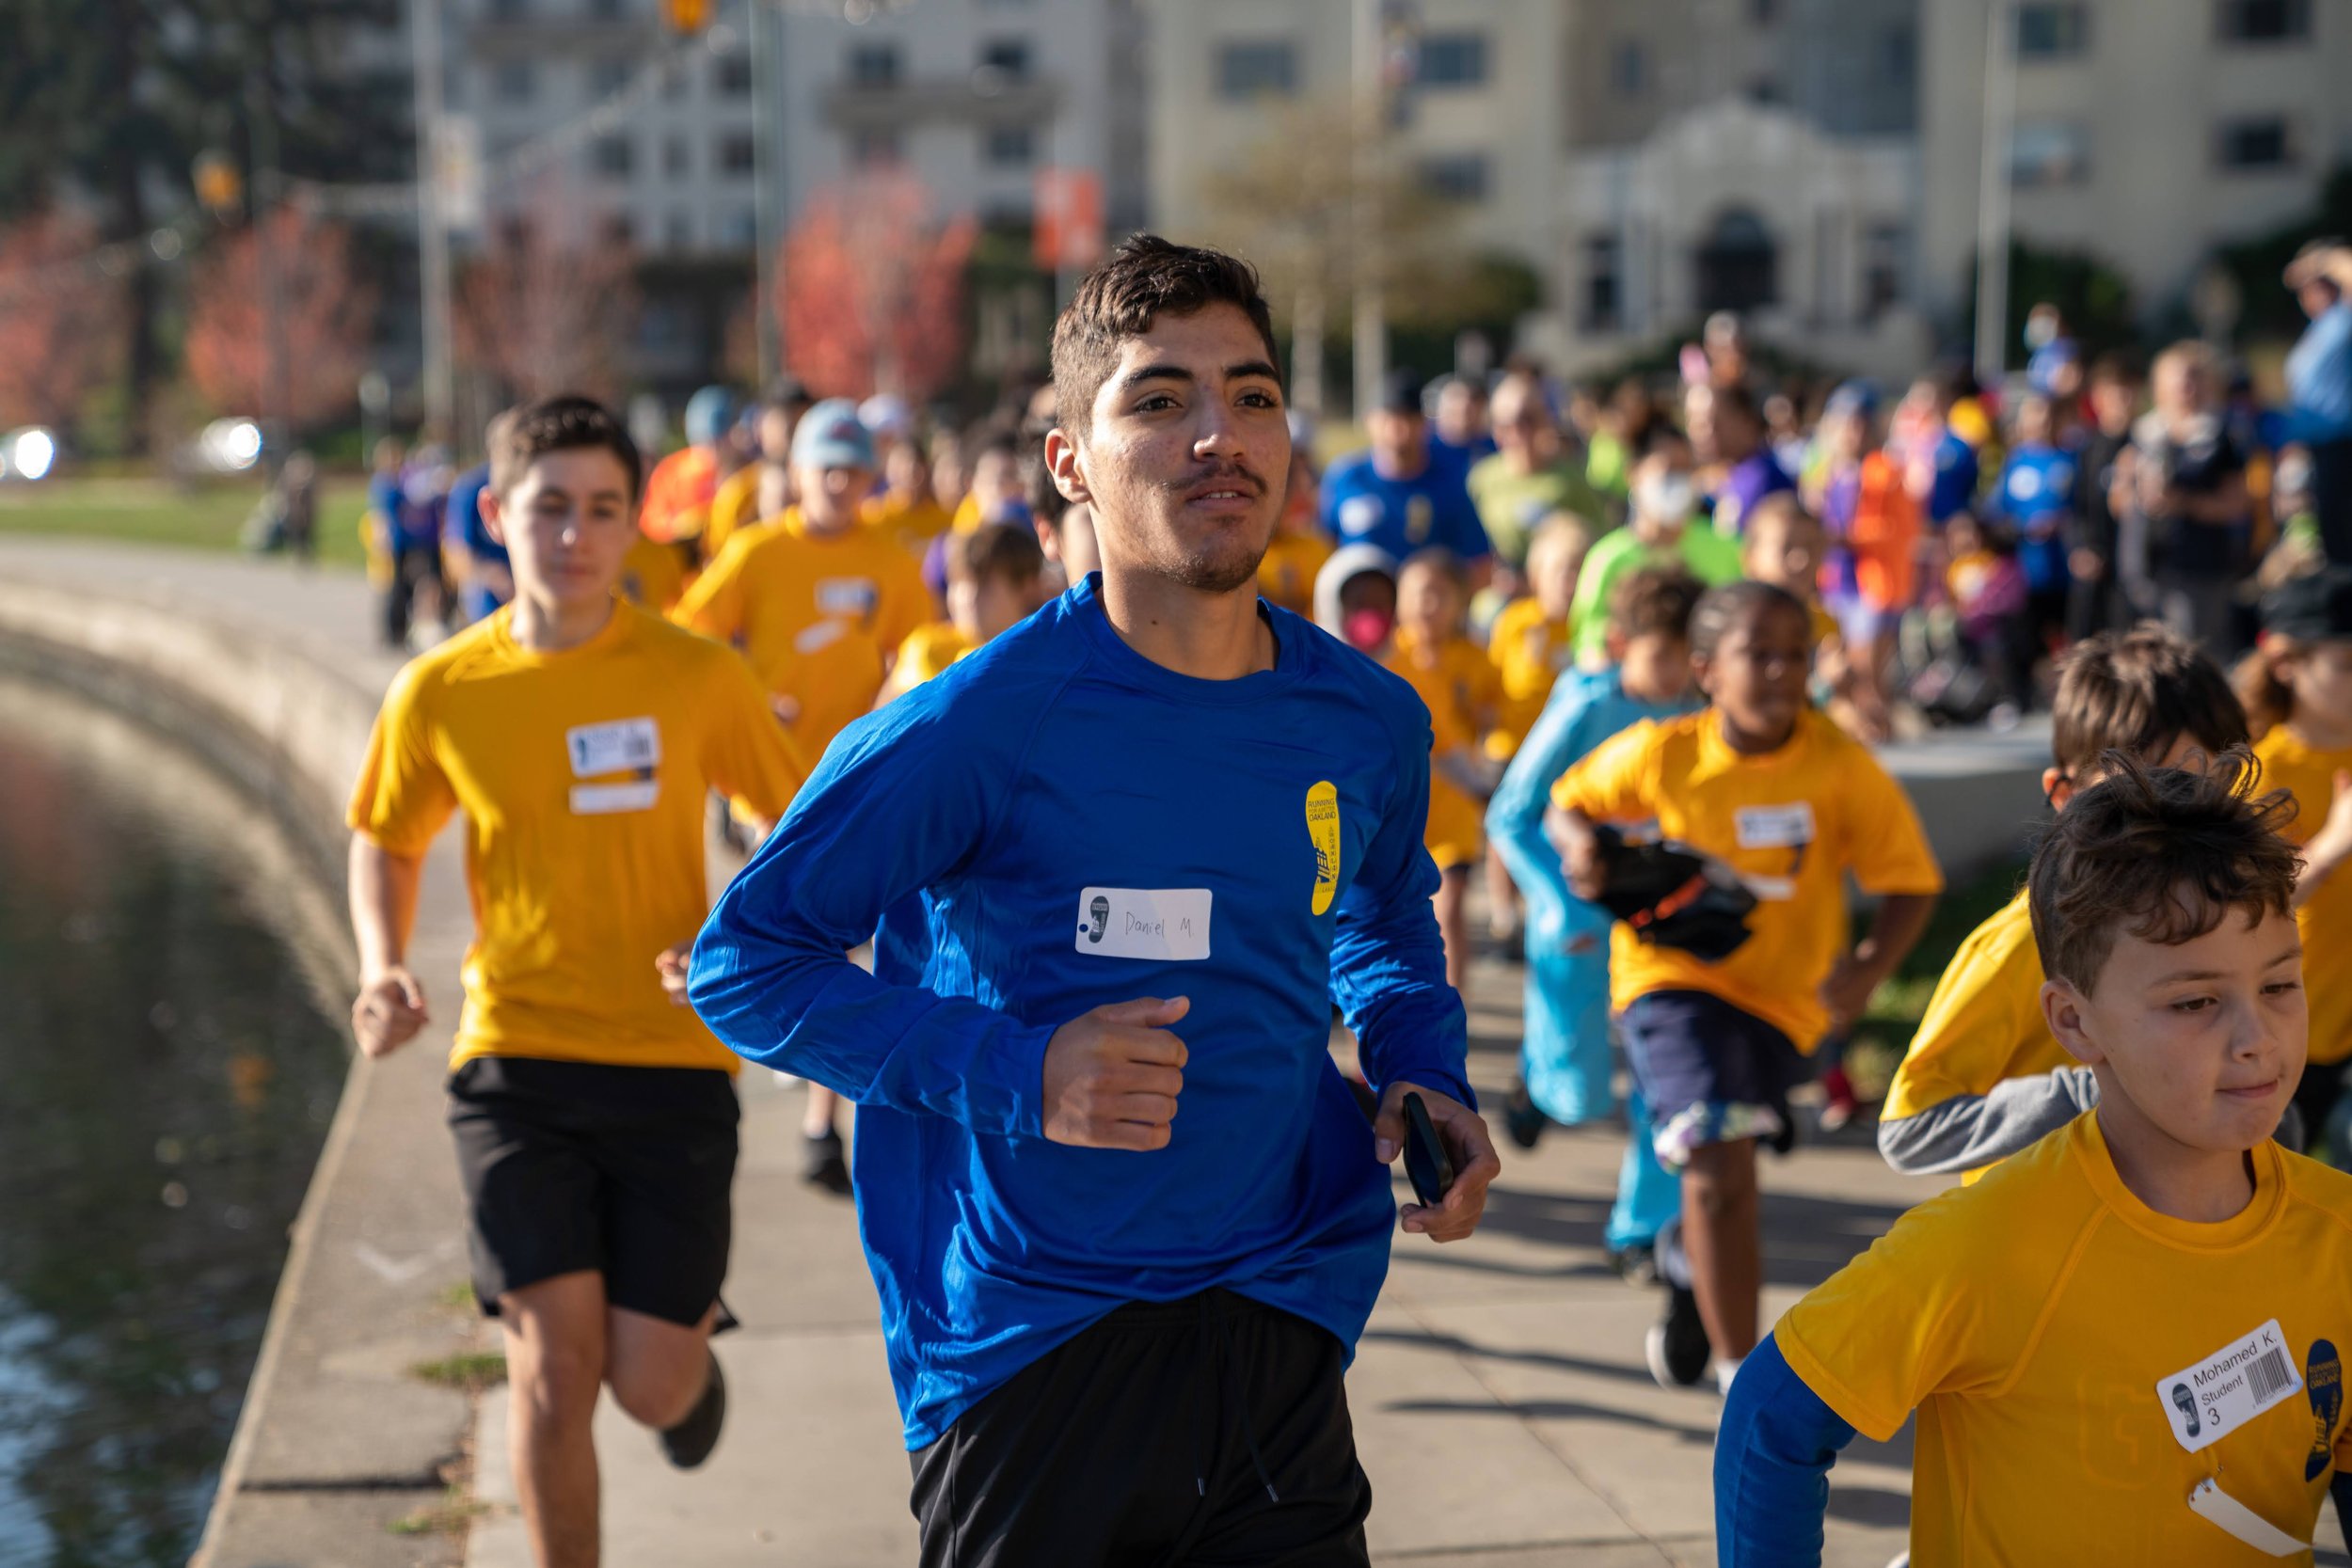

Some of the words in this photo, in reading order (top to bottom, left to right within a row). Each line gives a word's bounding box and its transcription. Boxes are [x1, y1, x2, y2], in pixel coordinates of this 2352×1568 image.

[1310, 812, 1336, 821] OAKLAND
[1125, 911, 1165, 938] Daniel
[2193, 1340, 2258, 1387] Mohamed
[2262, 1330, 2277, 1347] K.
[2201, 1375, 2244, 1405] Student
[2207, 1407, 2220, 1426] 3
